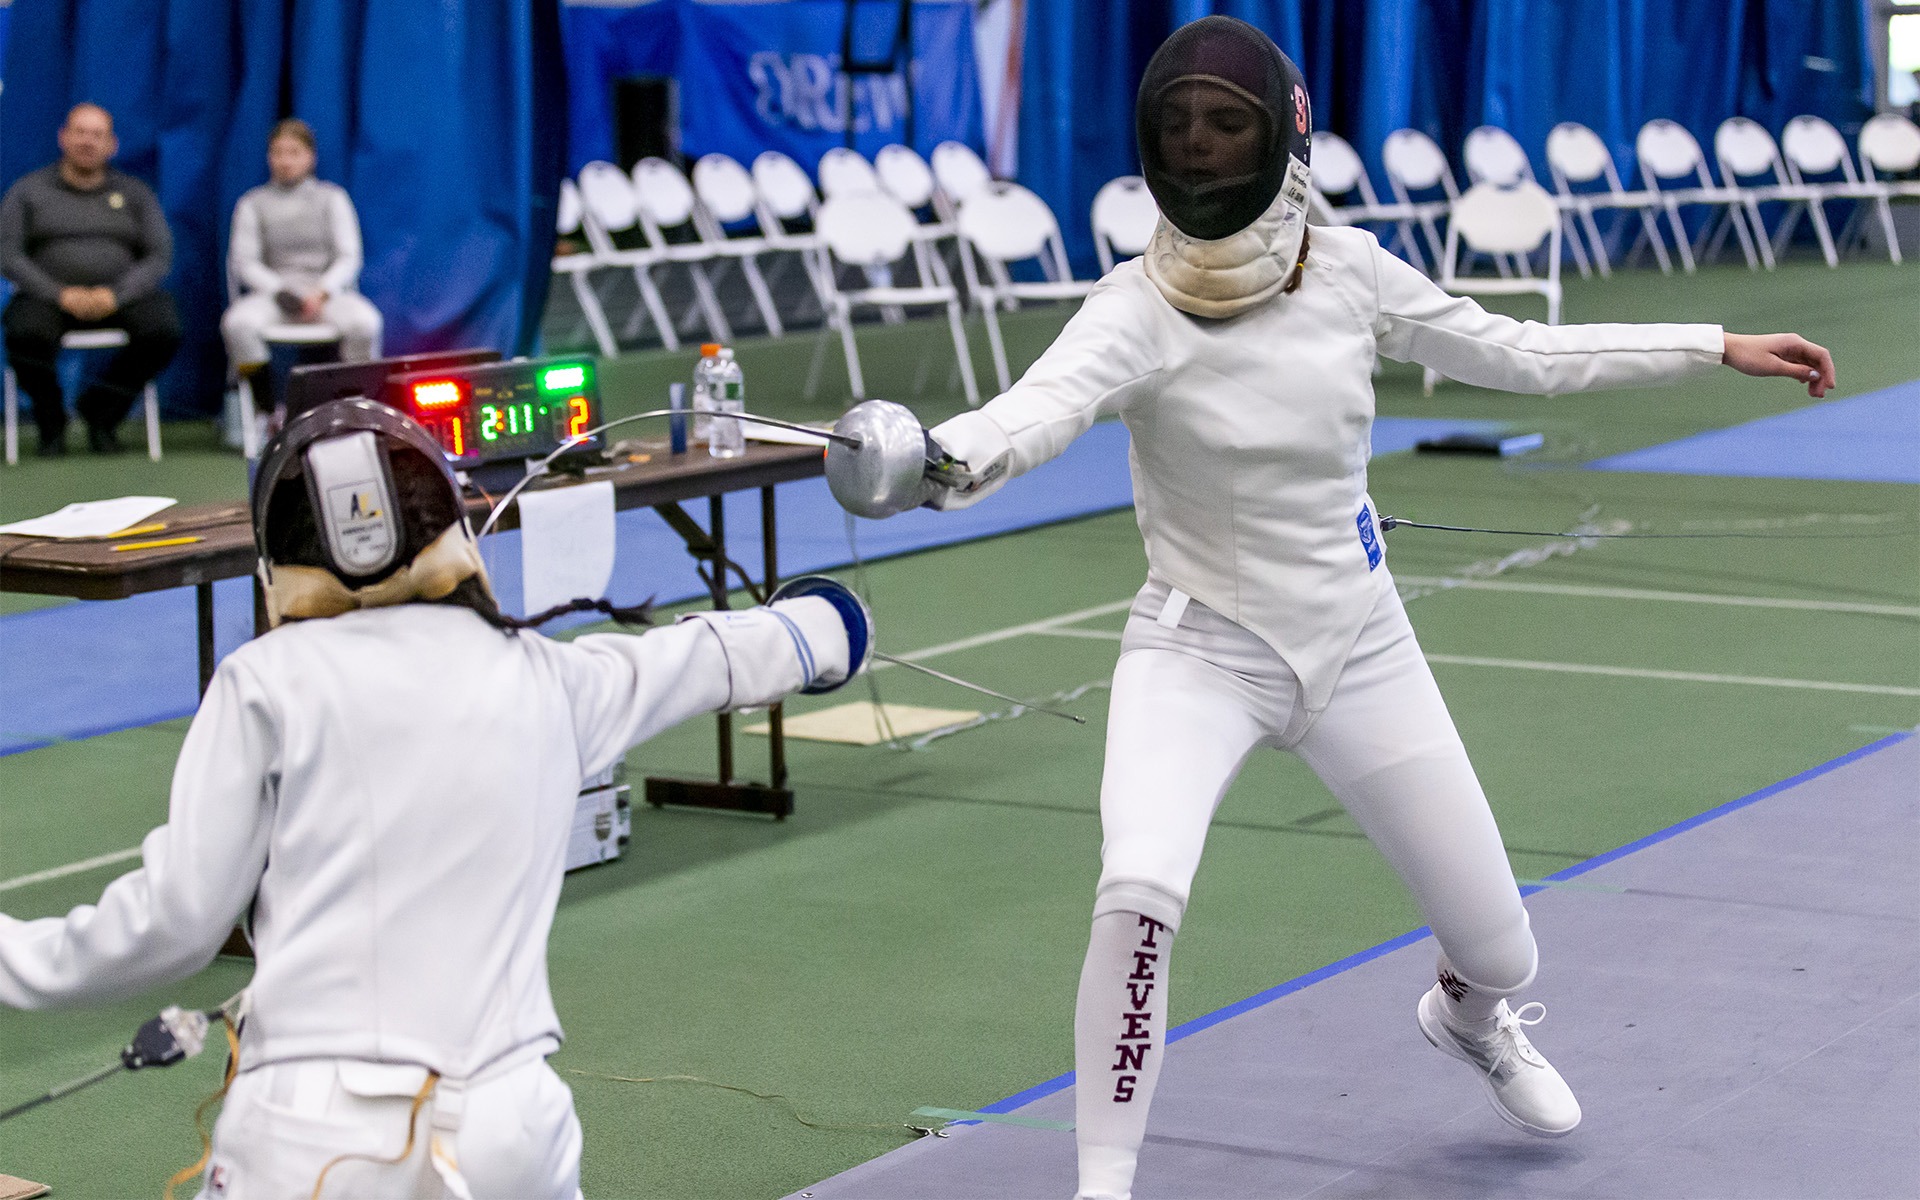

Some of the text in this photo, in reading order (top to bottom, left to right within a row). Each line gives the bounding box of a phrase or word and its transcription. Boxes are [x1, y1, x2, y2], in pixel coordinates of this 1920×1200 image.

[452, 416, 464, 456] 1
[480, 402, 535, 442] 2:11
[568, 396, 590, 444] 2
